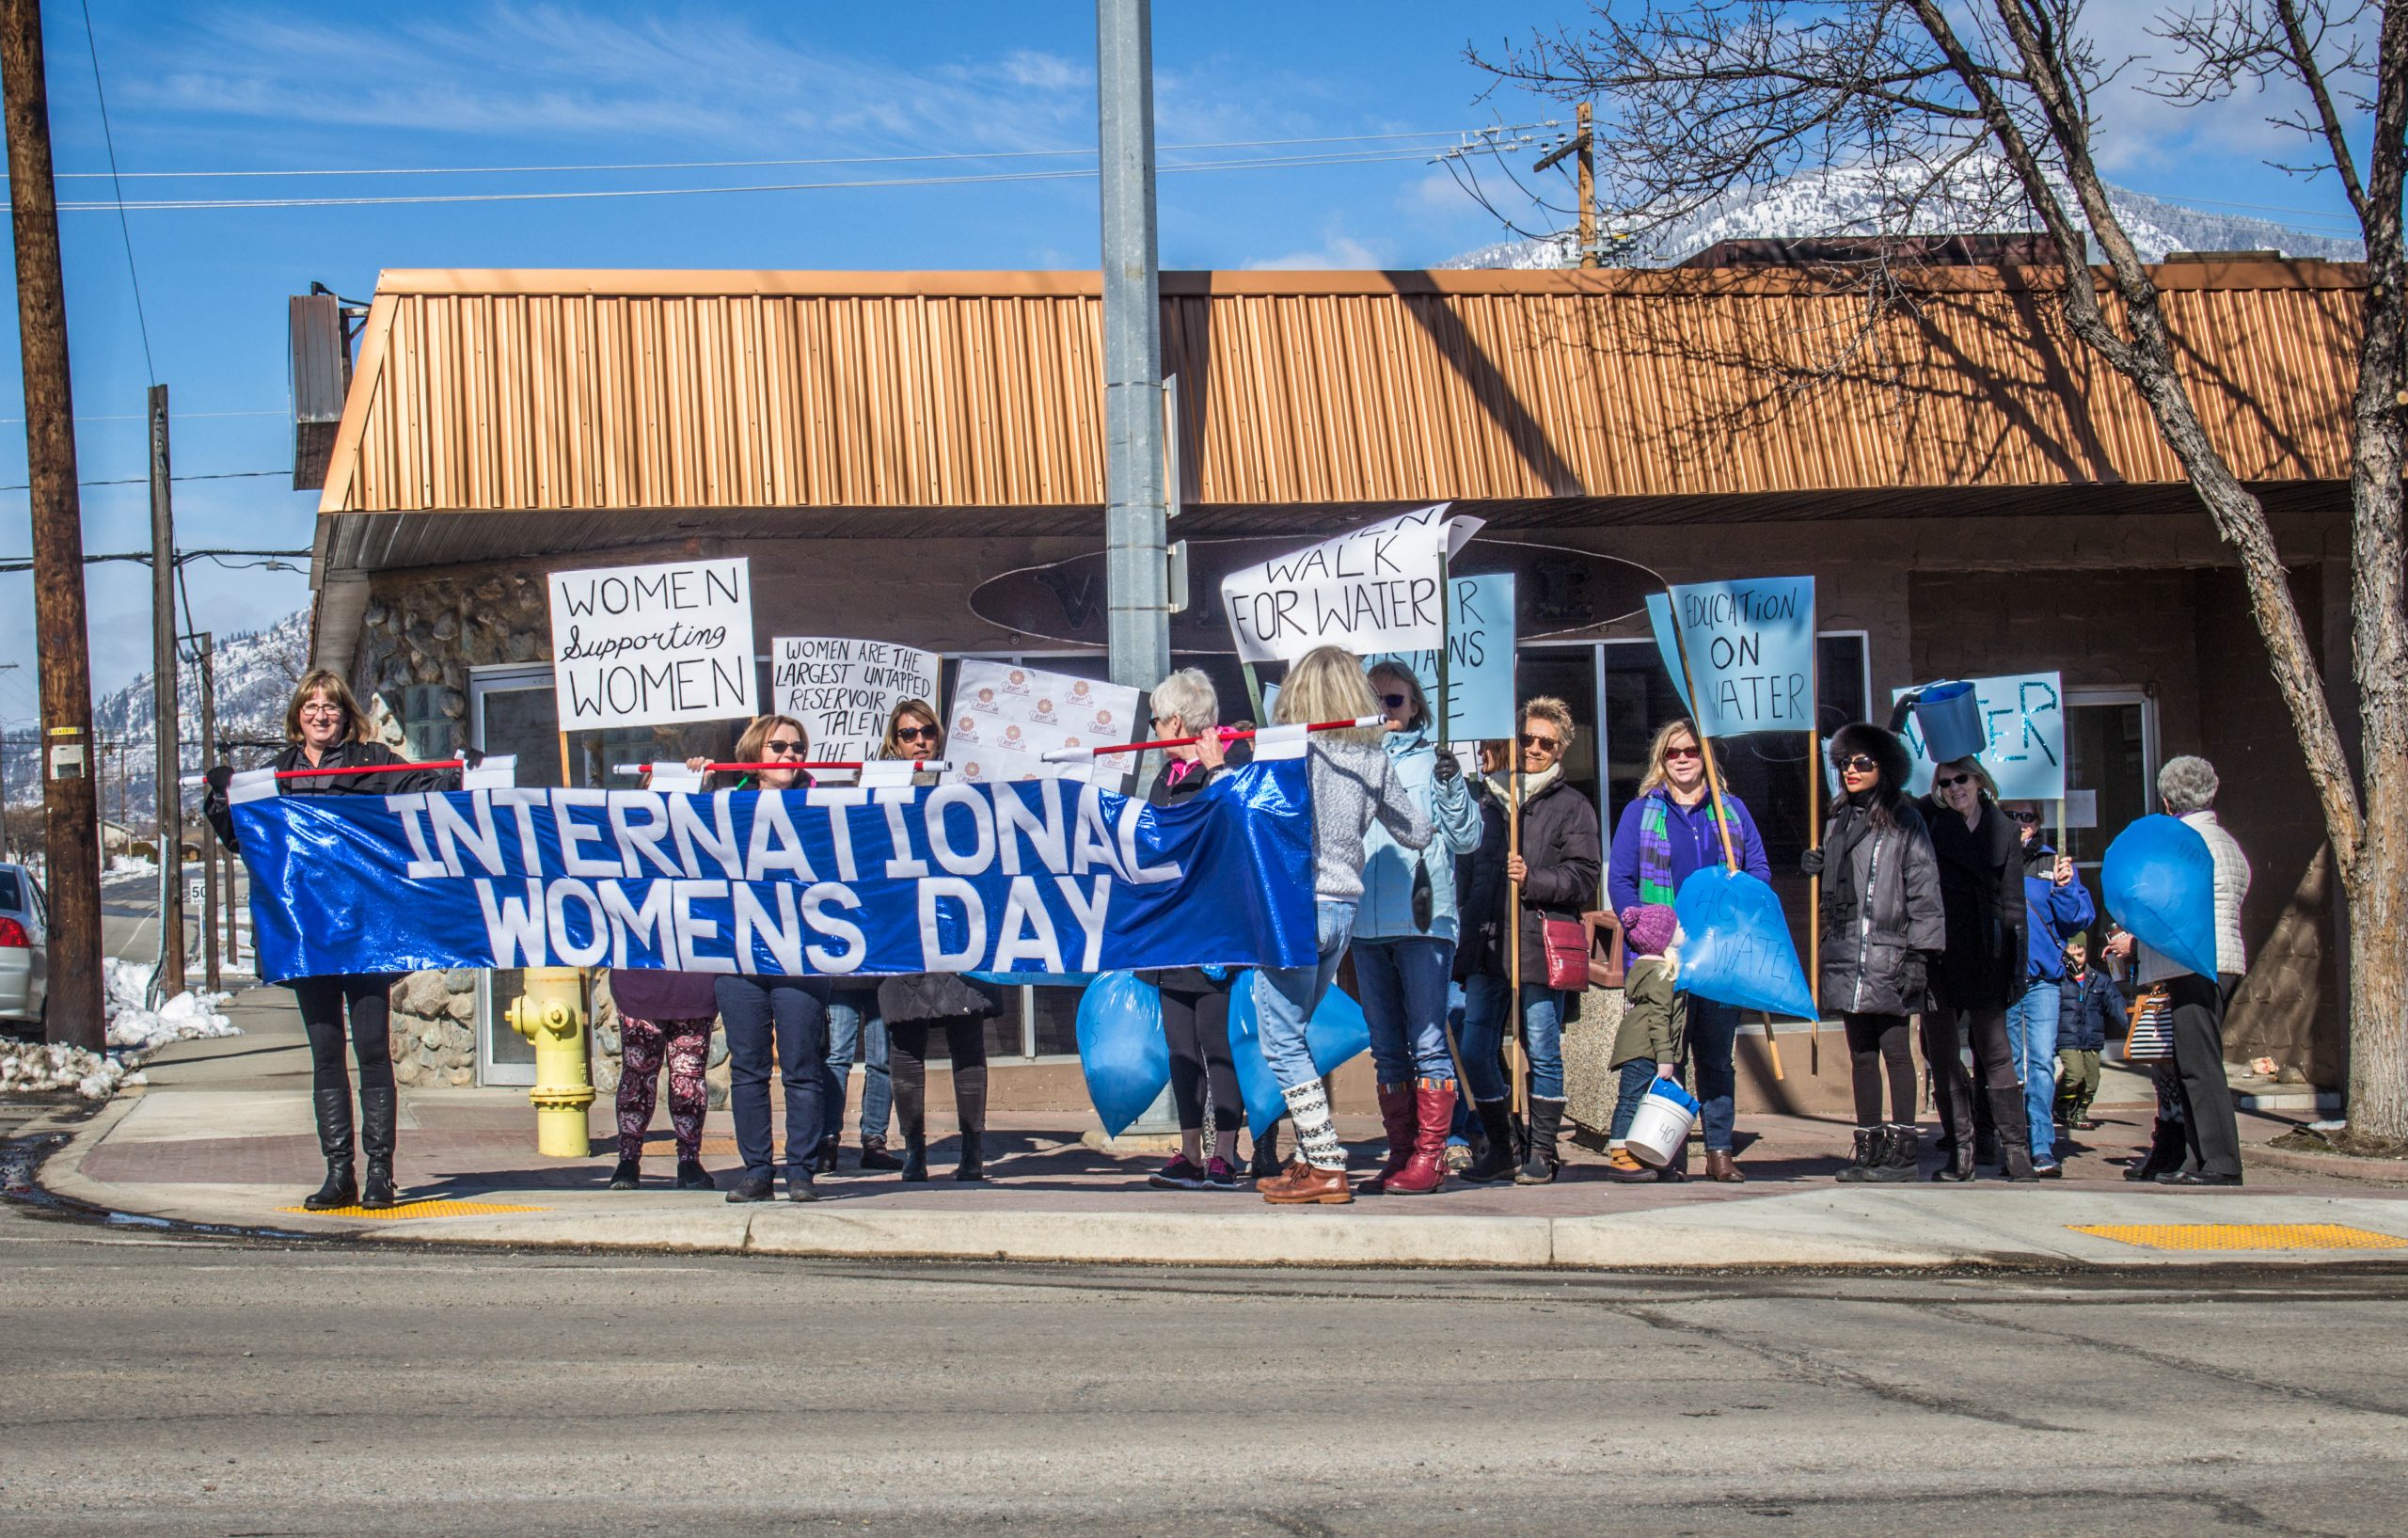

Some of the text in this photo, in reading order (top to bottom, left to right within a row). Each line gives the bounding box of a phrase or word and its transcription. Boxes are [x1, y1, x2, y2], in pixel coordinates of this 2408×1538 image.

[1265, 533, 1402, 584] WALK
[562, 567, 738, 617] WOMEN
[1231, 589, 1307, 644] FOR
[1314, 578, 1437, 637] WATER
[786, 641, 923, 674] WOMEN ARE THE
[1710, 631, 1760, 671] ON
[569, 656, 745, 718] WOMEN
[775, 662, 931, 699] LARGEST UNTAPPED
[788, 688, 886, 712] RESERVOIR
[1703, 673, 1805, 721] WATER
[385, 778, 1182, 884] INTERNATIONAL
[473, 874, 1112, 975] WOMENS DAY
[1694, 888, 1738, 922] 40
[1659, 1122, 1676, 1144] 40
